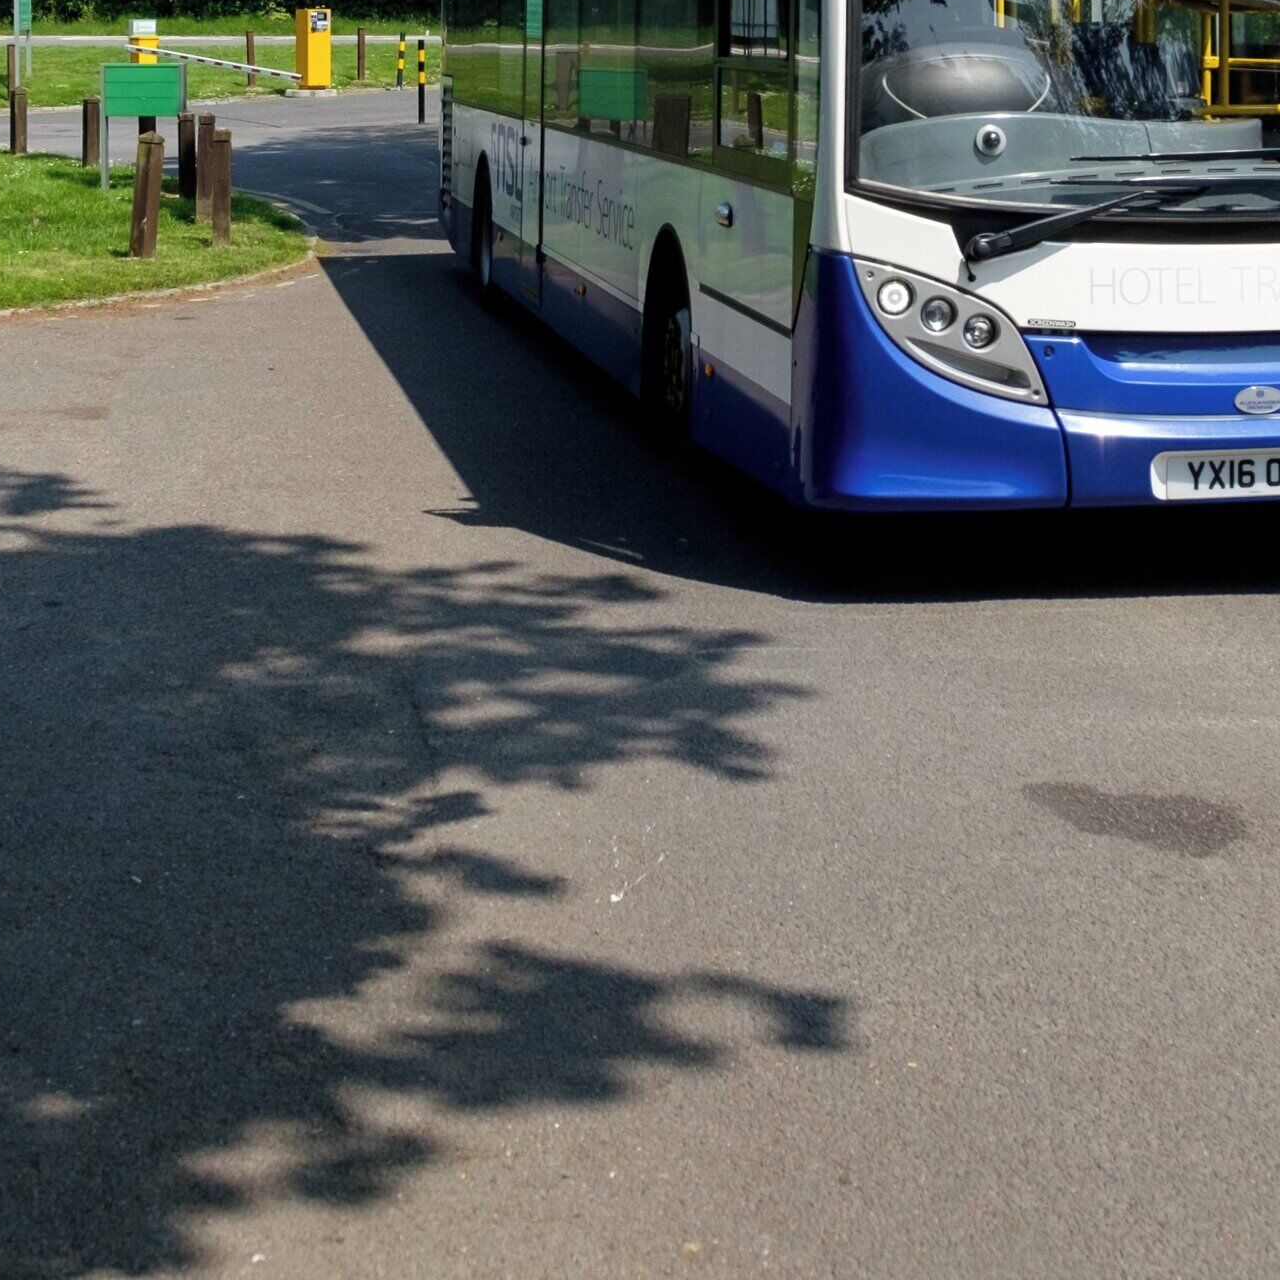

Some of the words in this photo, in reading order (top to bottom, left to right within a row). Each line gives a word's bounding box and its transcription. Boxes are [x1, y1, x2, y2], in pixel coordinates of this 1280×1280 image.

[527, 154, 557, 215] Airort
[560, 165, 594, 230] Transfer
[596, 179, 634, 251] Service
[1089, 267, 1217, 305] HOTEL
[1187, 459, 1256, 490] YX16
